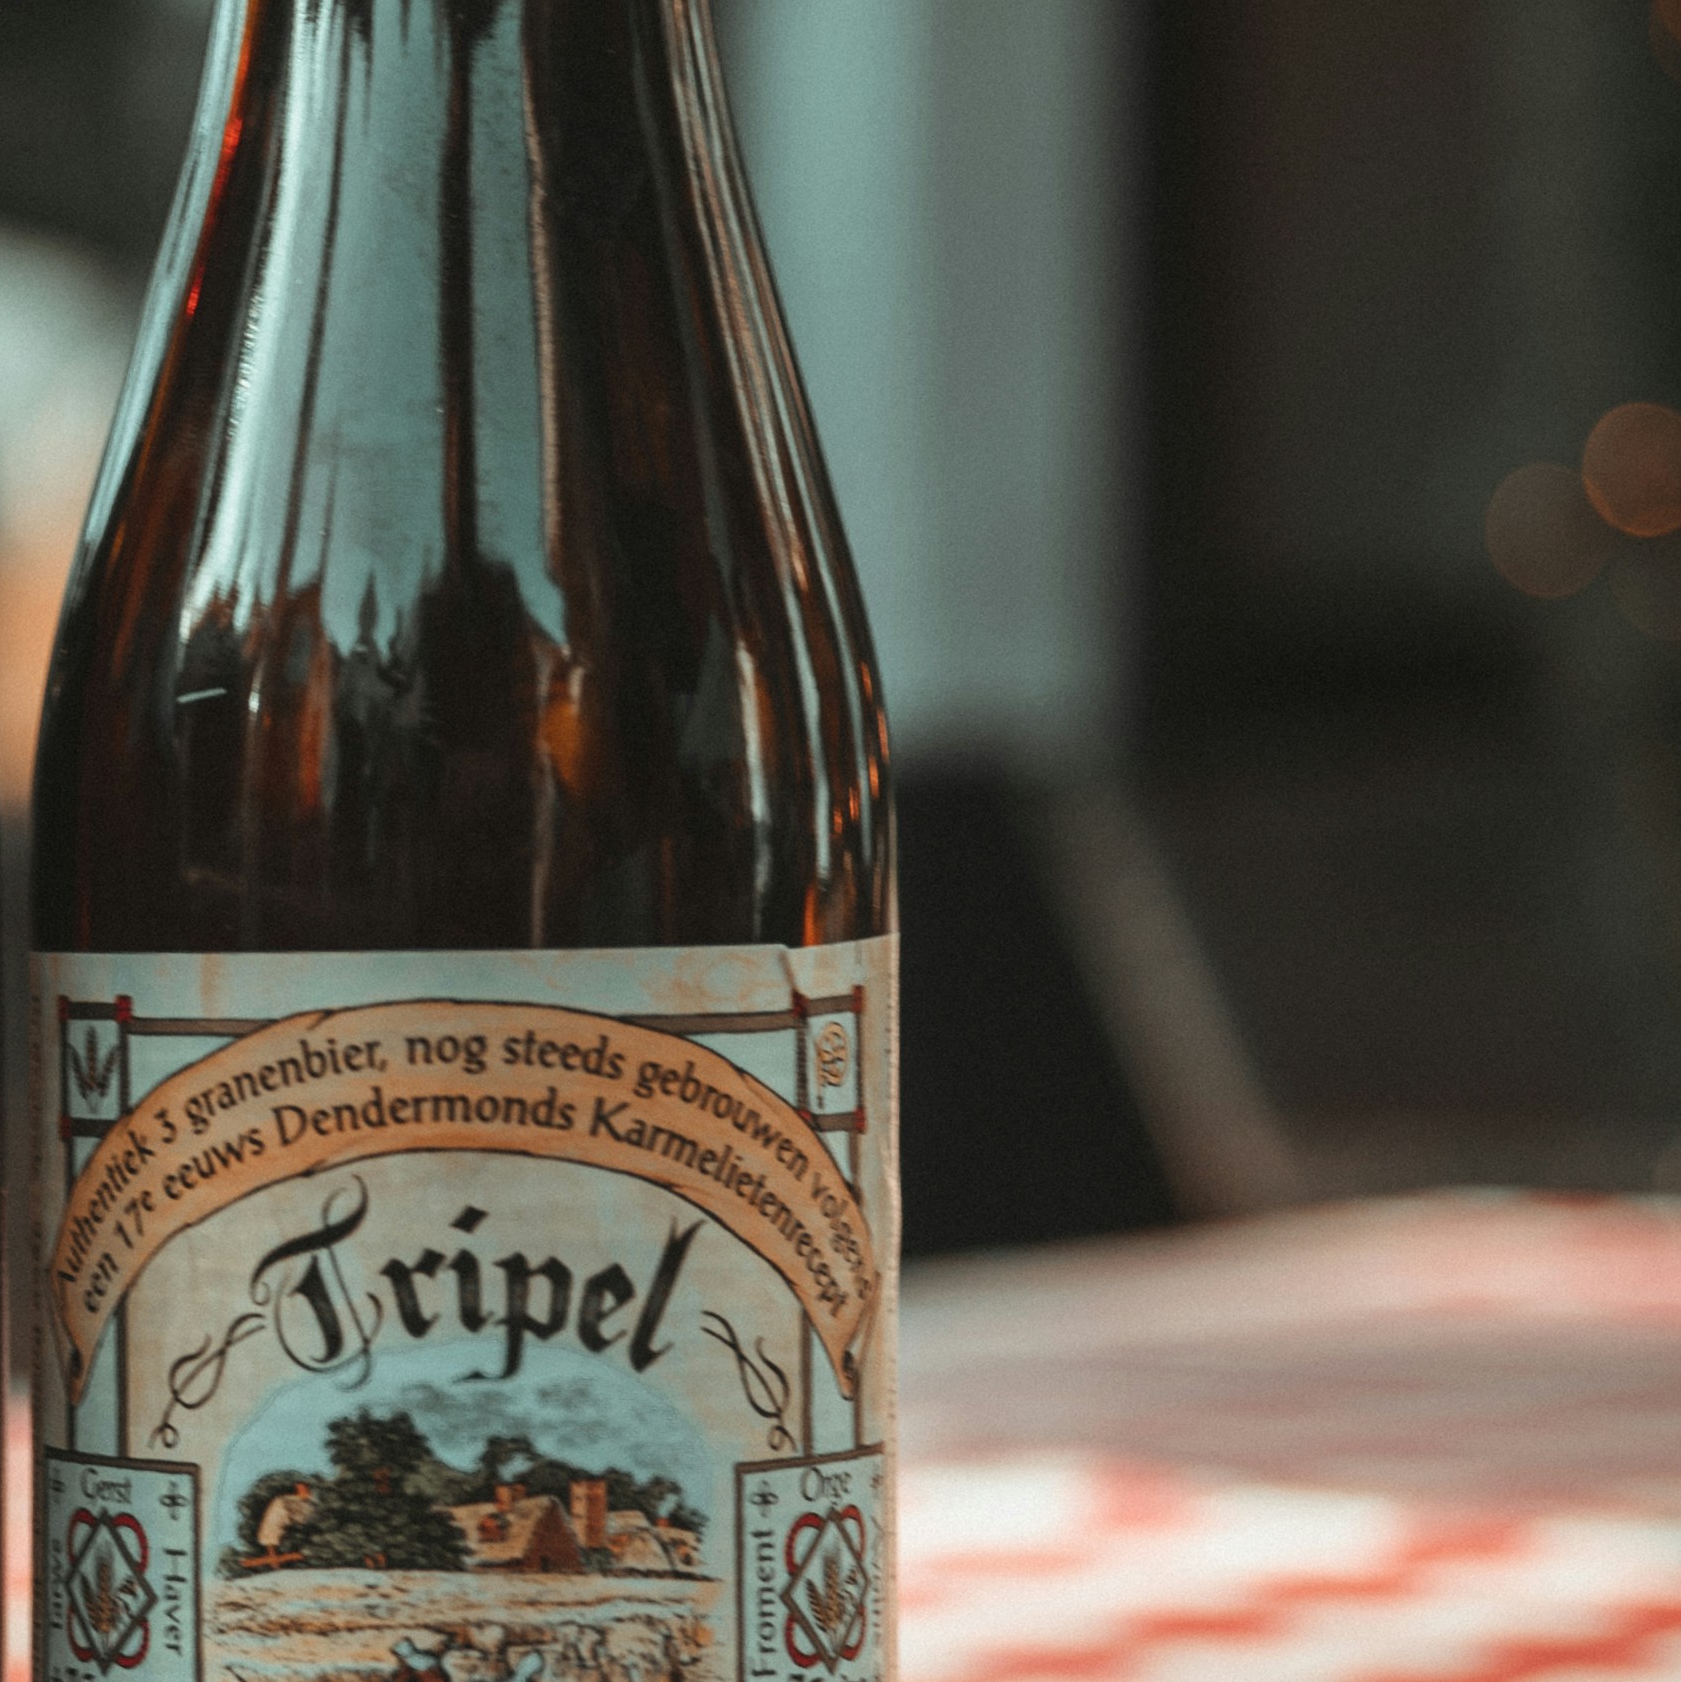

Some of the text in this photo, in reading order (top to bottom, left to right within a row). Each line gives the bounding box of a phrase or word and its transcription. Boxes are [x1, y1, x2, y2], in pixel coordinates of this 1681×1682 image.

[154, 1106, 177, 1145] 3
[184, 1038, 388, 1135] granenbier,
[405, 1034, 488, 1075] nog
[503, 1030, 626, 1080] steeds
[633, 1060, 809, 1182] gebrouwen
[83, 1251, 119, 1314] een
[163, 1128, 266, 1201] eeuws
[271, 1085, 577, 1146] Dendermonds
[589, 1096, 849, 1319] Karmelietenrecept
[250, 1173, 708, 1392] Tripel
[163, 1548, 188, 1656] Haver
[750, 1529, 778, 1677] Froment
